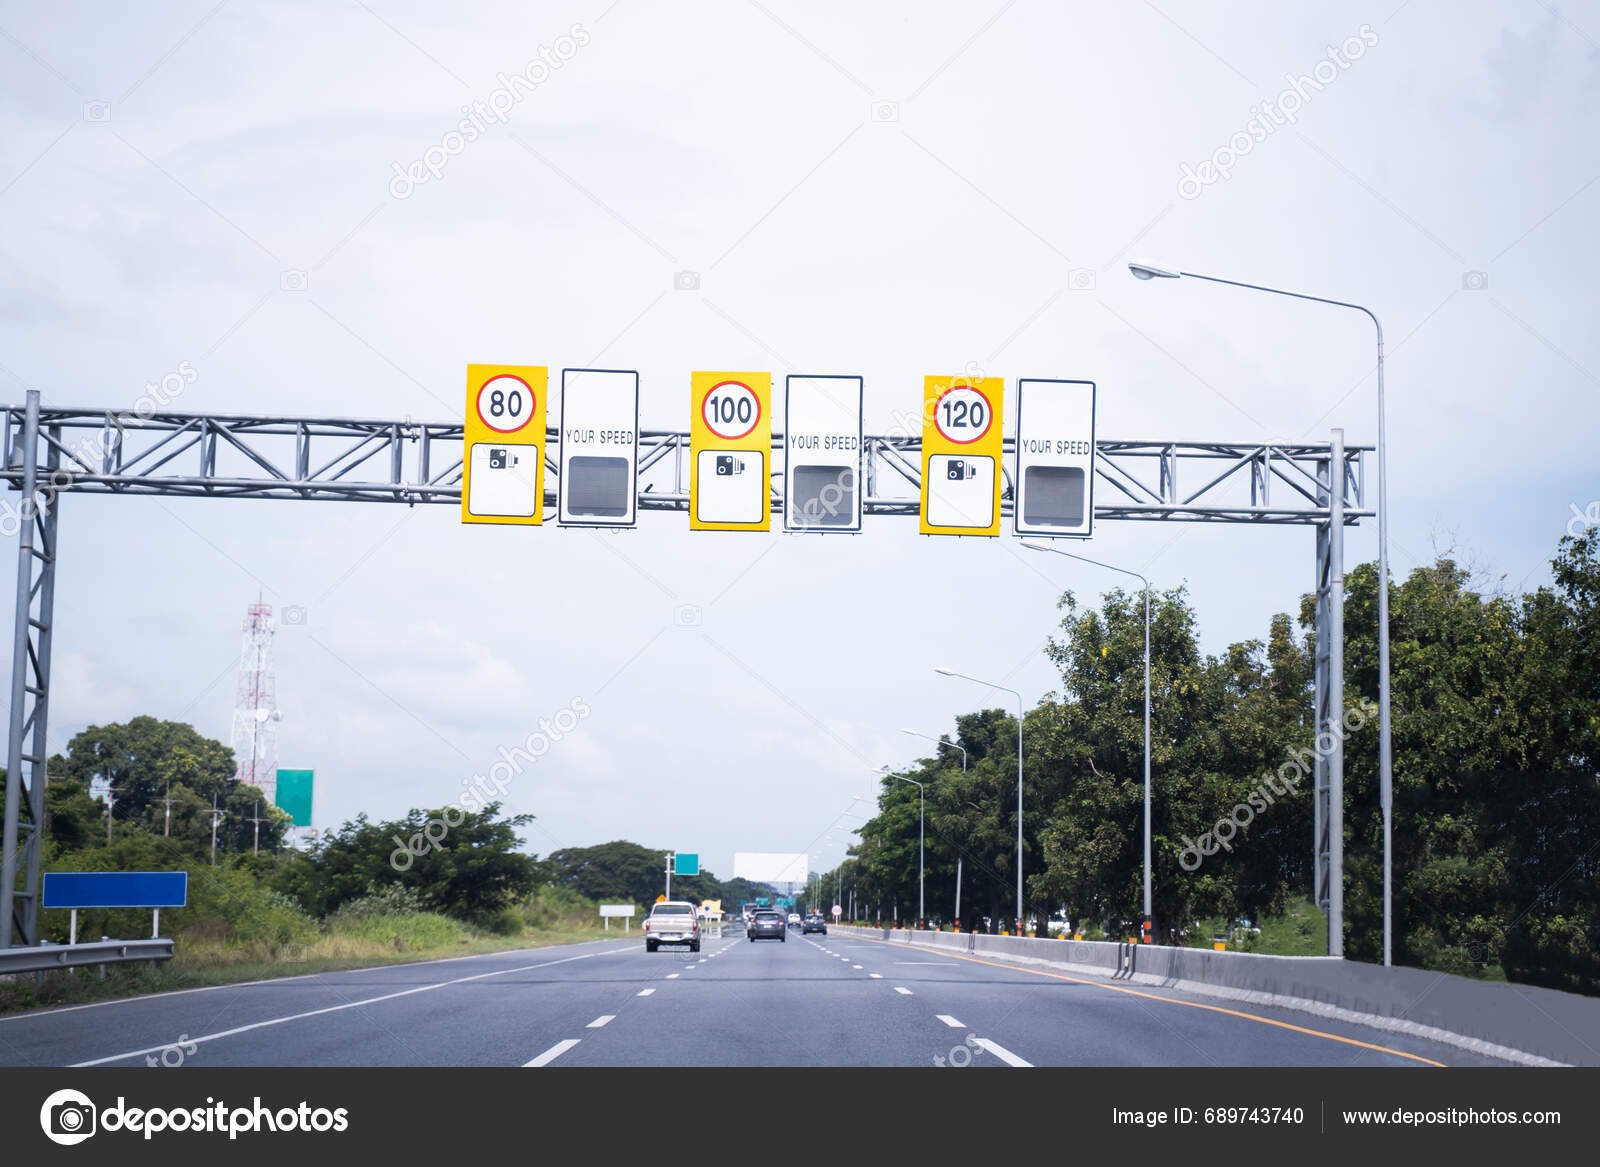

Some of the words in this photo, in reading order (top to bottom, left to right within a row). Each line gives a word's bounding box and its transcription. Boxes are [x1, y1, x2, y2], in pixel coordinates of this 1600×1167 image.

[489, 389, 522, 417] 80
[710, 395, 751, 424] 100
[943, 400, 984, 428] 120
[565, 430, 595, 444] YOUR
[600, 430, 633, 445] SPEED
[790, 434, 820, 449] YOUR
[824, 435, 858, 450] SPEED
[1022, 439, 1051, 454] YOUR
[1057, 440, 1090, 456] SPEED
